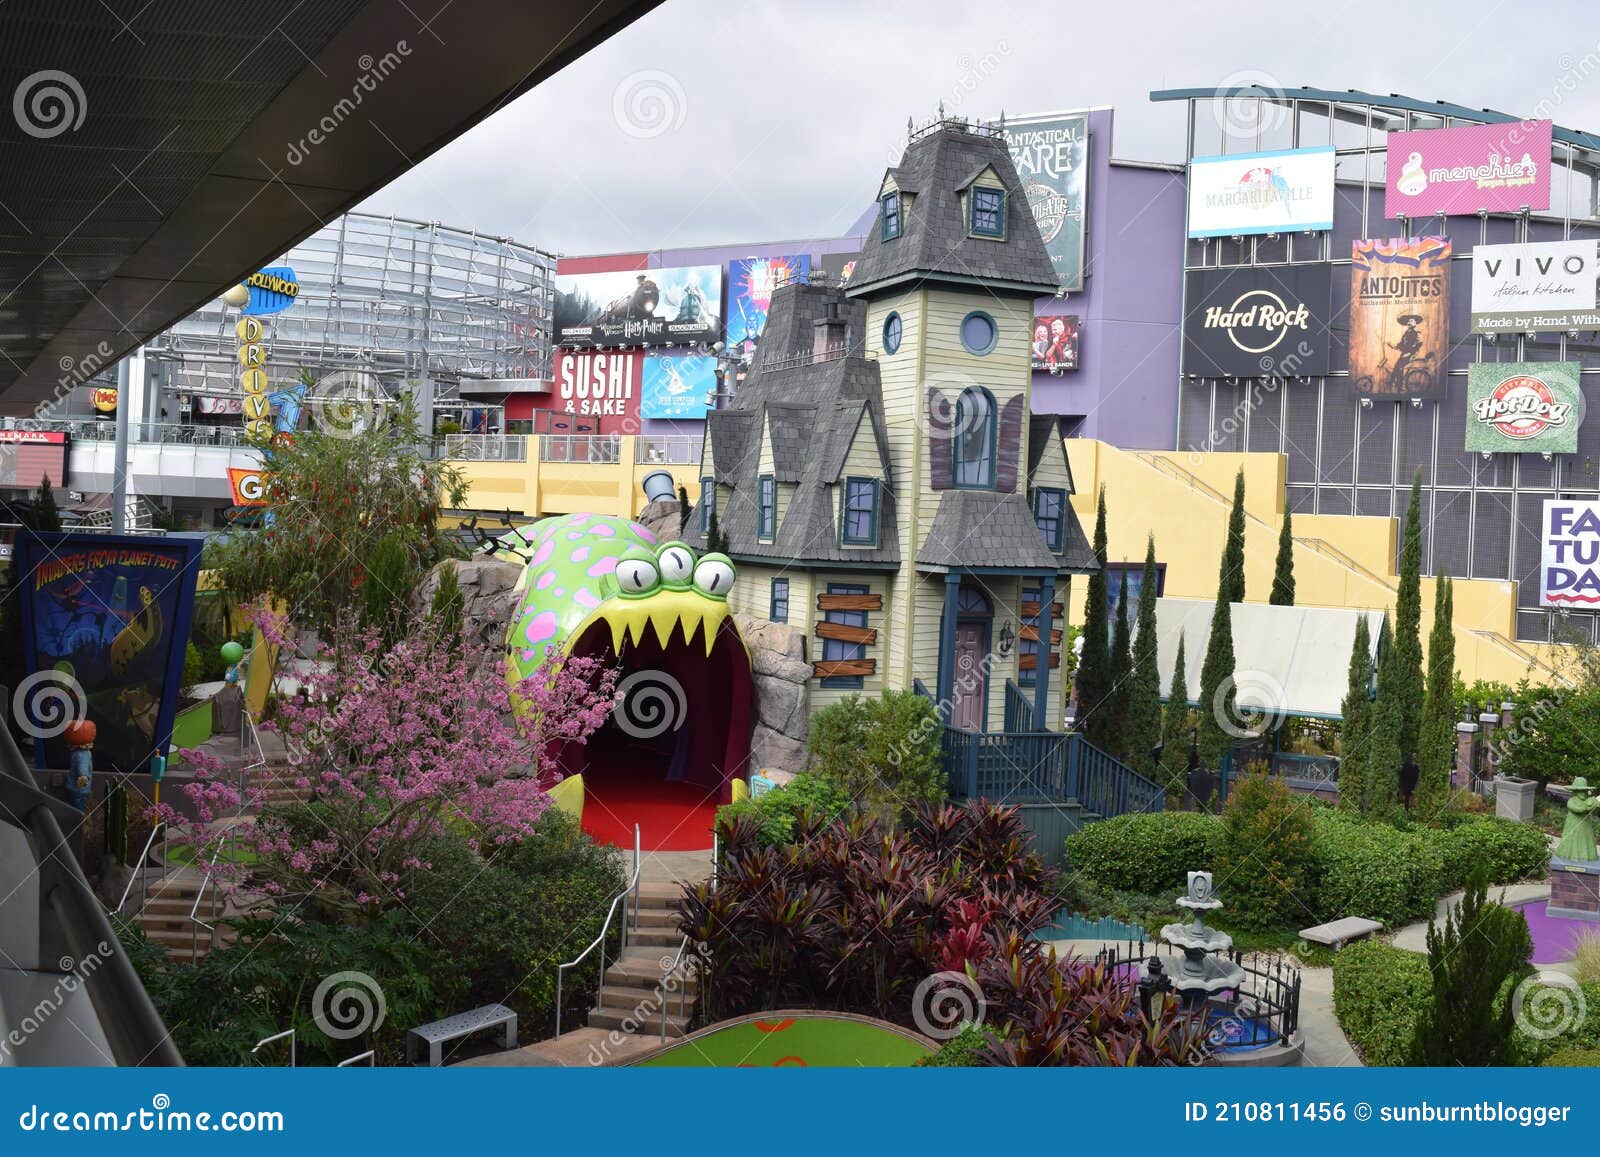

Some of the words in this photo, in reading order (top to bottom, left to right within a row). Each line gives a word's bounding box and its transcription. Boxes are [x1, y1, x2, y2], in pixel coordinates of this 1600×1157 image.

[1430, 152, 1537, 183] menchie's
[1206, 186, 1313, 208] MARGARITAVILLE
[1484, 256, 1584, 278] VIVO
[247, 276, 299, 297] HOLLYWOOD
[1360, 276, 1441, 298] ANTOJITOS
[1204, 305, 1257, 328] Hard
[1258, 303, 1309, 331] Rock
[1479, 318, 1512, 328] Made
[1515, 317, 1530, 328] by
[1533, 316, 1570, 327] Hand.
[1572, 314, 1600, 326] With
[561, 355, 632, 399] SUSHI
[565, 400, 575, 413] &
[581, 400, 625, 415] SAKE
[1477, 397, 1518, 420] Hot
[1520, 395, 1568, 422] Dog
[87, 549, 117, 569] FROM
